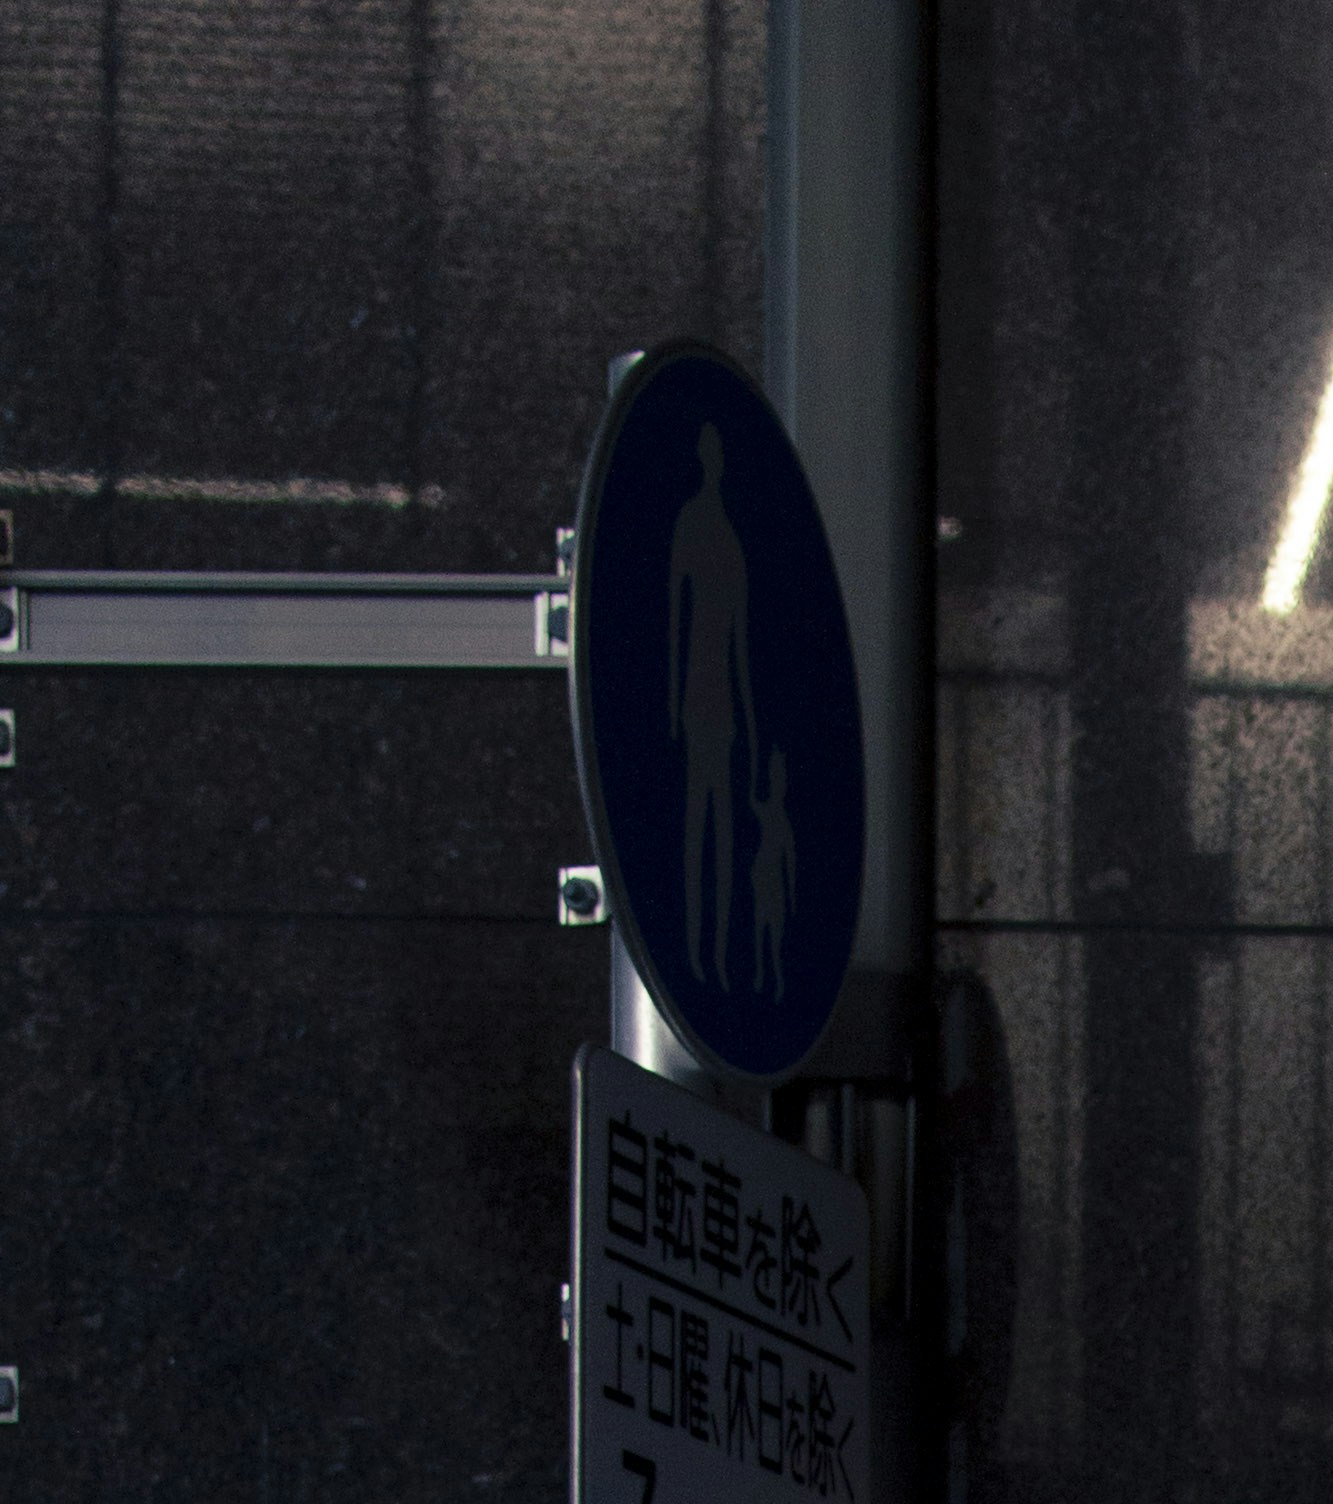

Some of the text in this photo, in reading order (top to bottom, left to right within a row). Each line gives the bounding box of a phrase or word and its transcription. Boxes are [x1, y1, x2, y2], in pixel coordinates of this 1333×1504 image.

[606, 1111, 855, 1342] 自転車を除く
